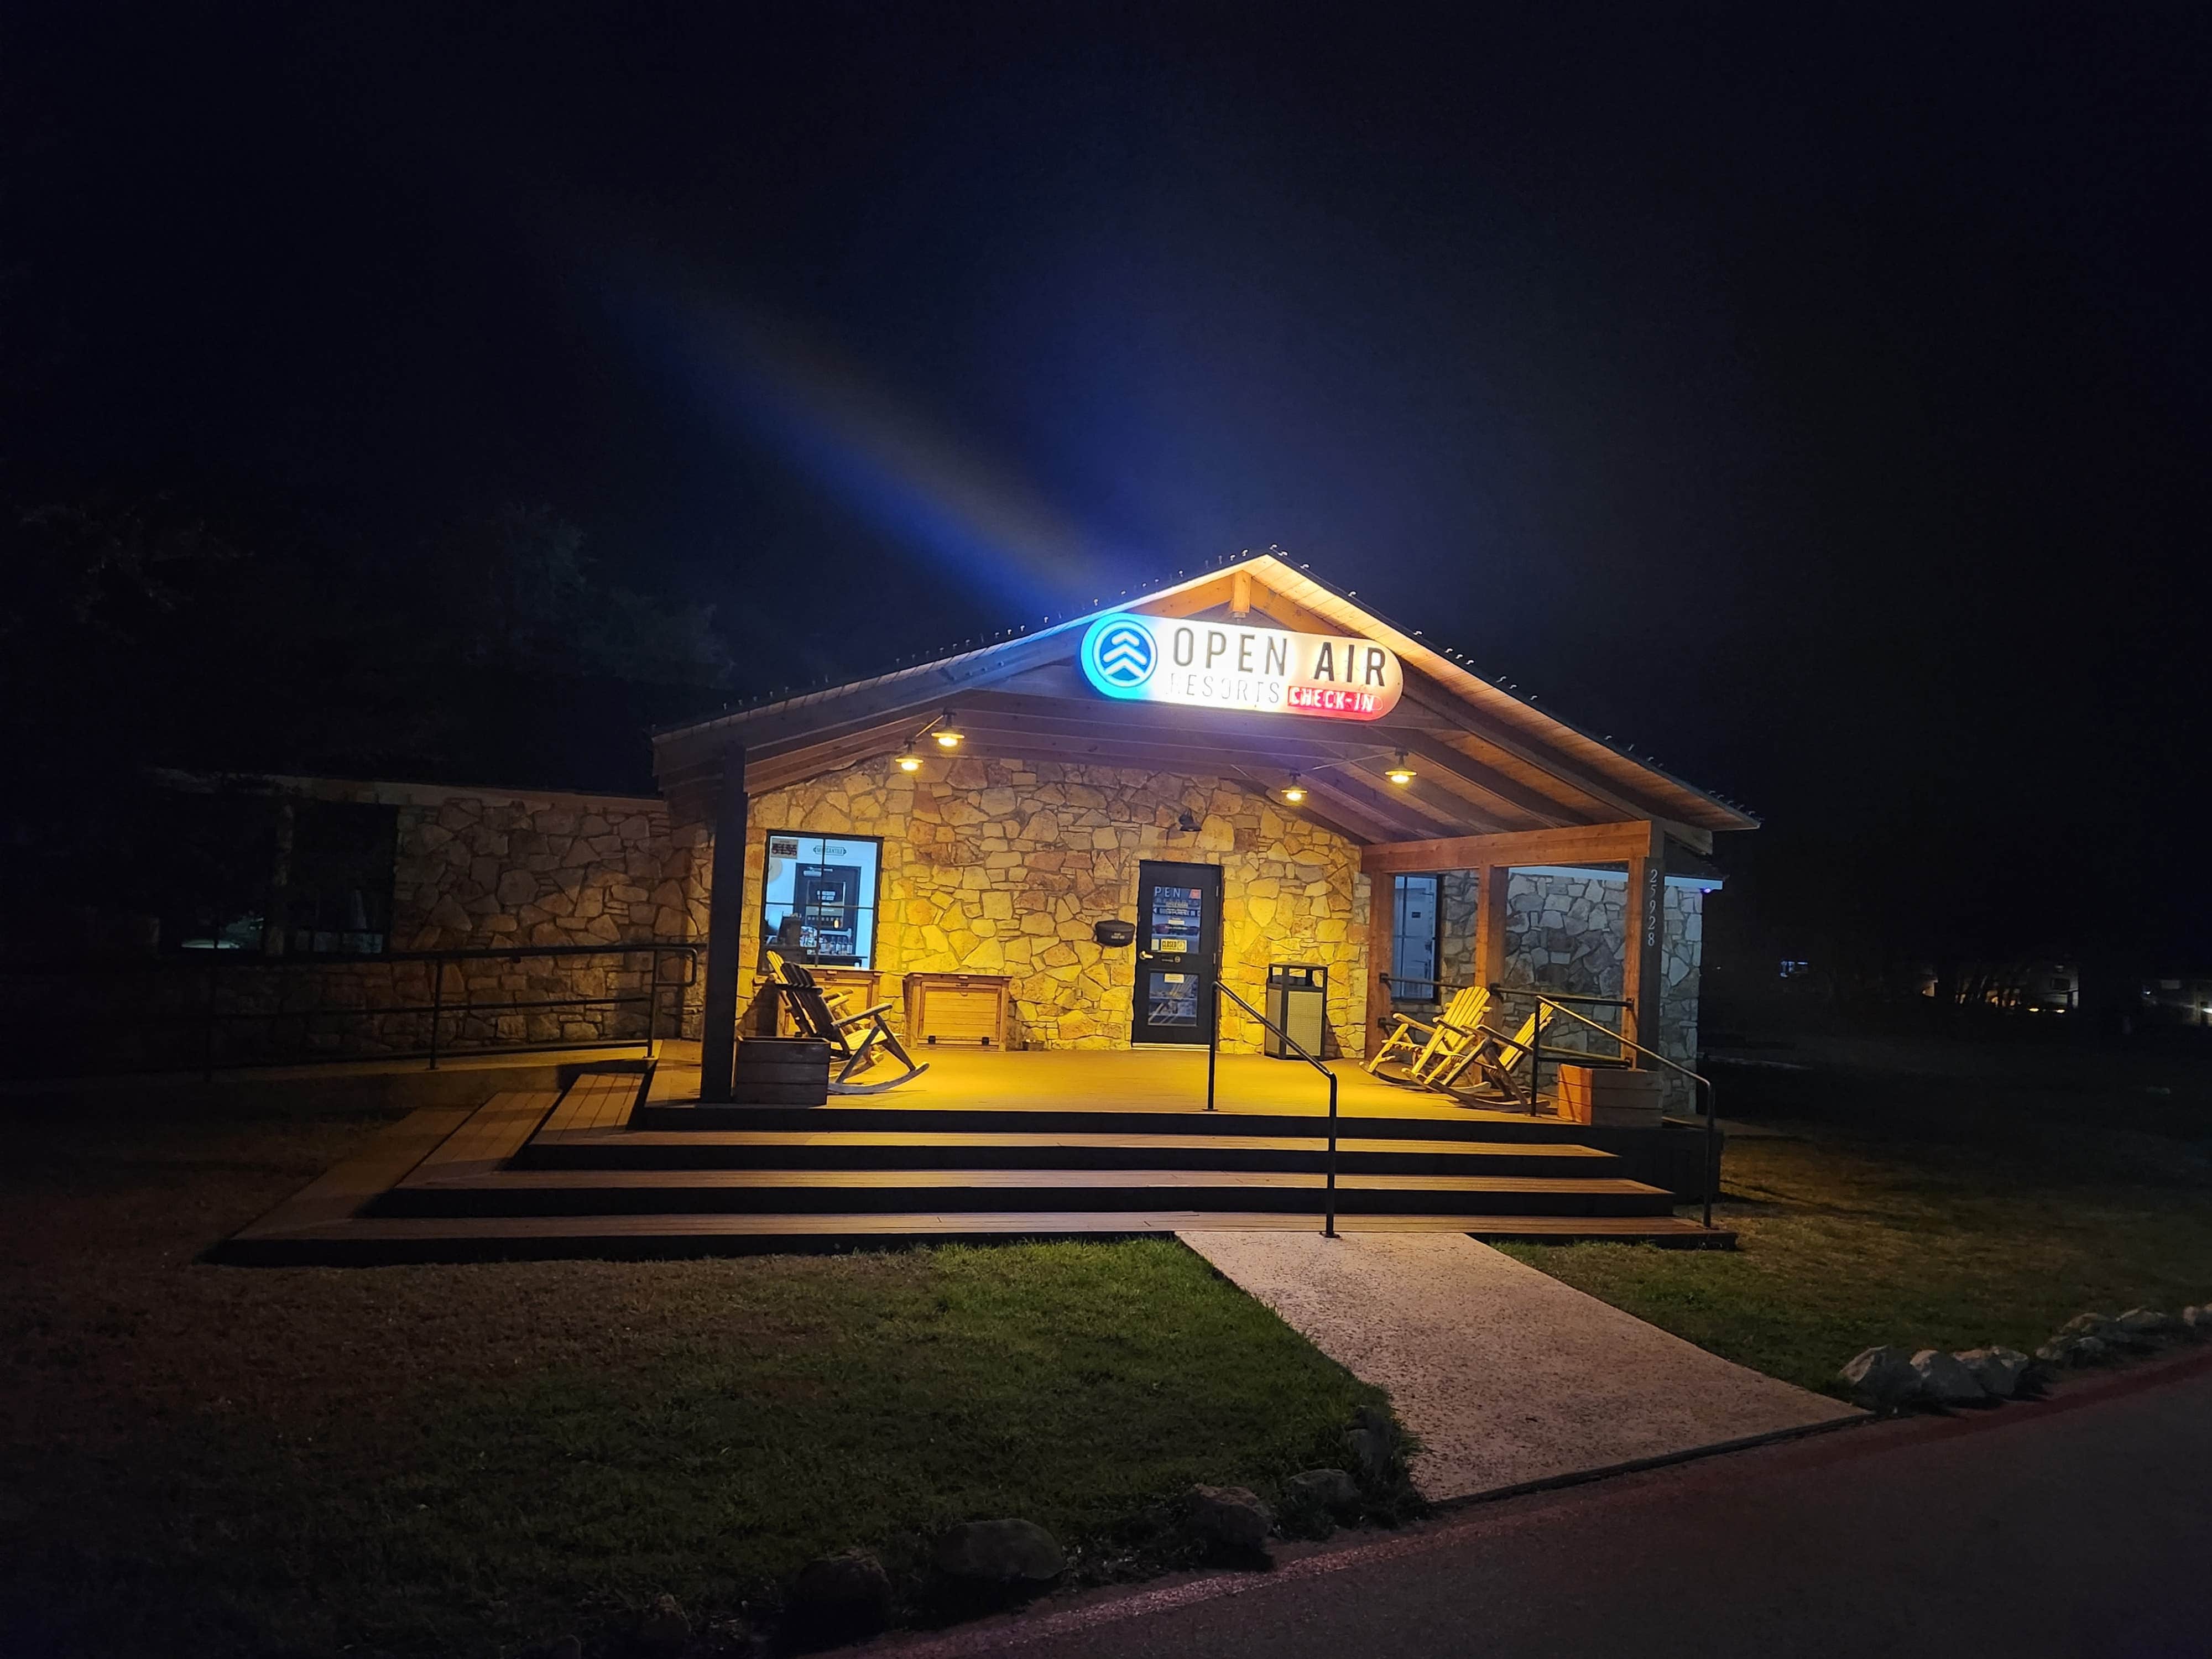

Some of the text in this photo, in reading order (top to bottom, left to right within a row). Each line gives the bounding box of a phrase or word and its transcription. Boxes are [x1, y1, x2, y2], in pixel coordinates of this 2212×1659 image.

[1173, 627, 1386, 687] OPEN AIR
[1289, 687, 1374, 712] CHECK-IN
[1647, 869, 1658, 947] 25928
